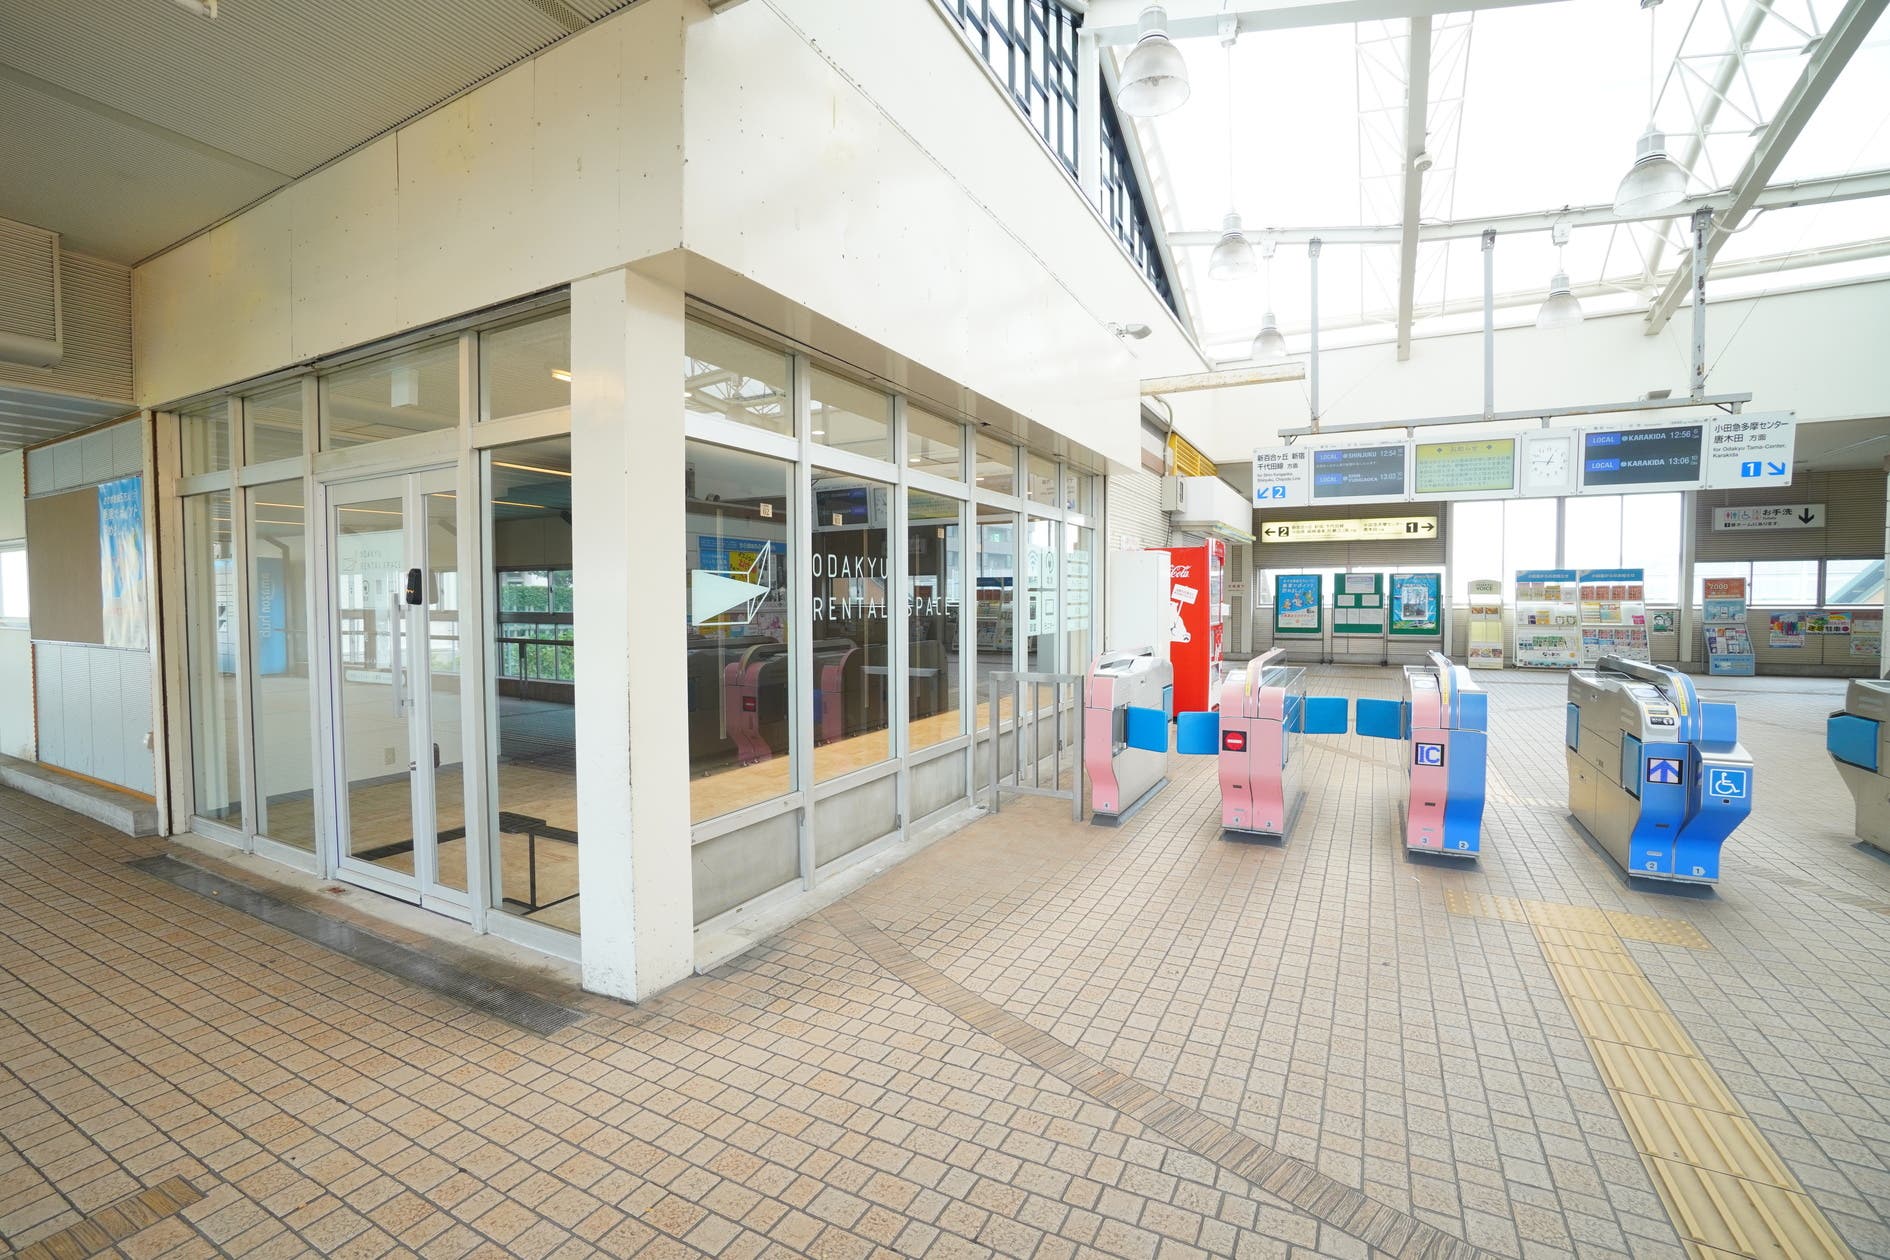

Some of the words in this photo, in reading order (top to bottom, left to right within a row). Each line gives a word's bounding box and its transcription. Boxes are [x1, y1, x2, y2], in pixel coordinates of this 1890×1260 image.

[1713, 420, 1789, 433] 小田急多摩センター
[1592, 436, 1615, 444] LOCAL
[1627, 432, 1667, 441] KARAKIDA
[1670, 430, 1691, 438] 12:56
[1713, 433, 1744, 443] 唐木田
[1748, 433, 1767, 441] 方面
[1291, 452, 1306, 460] 新宿
[1257, 461, 1284, 471] 千代田線
[1591, 461, 1614, 470] LOCAL
[1626, 458, 1666, 467] KARAKIDA
[1668, 457, 1690, 465] 13:06
[1747, 463, 1757, 476] 1
[1273, 487, 1284, 497] 2
[1762, 508, 1793, 516] お手洗
[812, 552, 888, 580] ODAKYU
[812, 596, 889, 622] RENTAL
[905, 596, 951, 618] SPACE
[1417, 744, 1441, 765] IC
